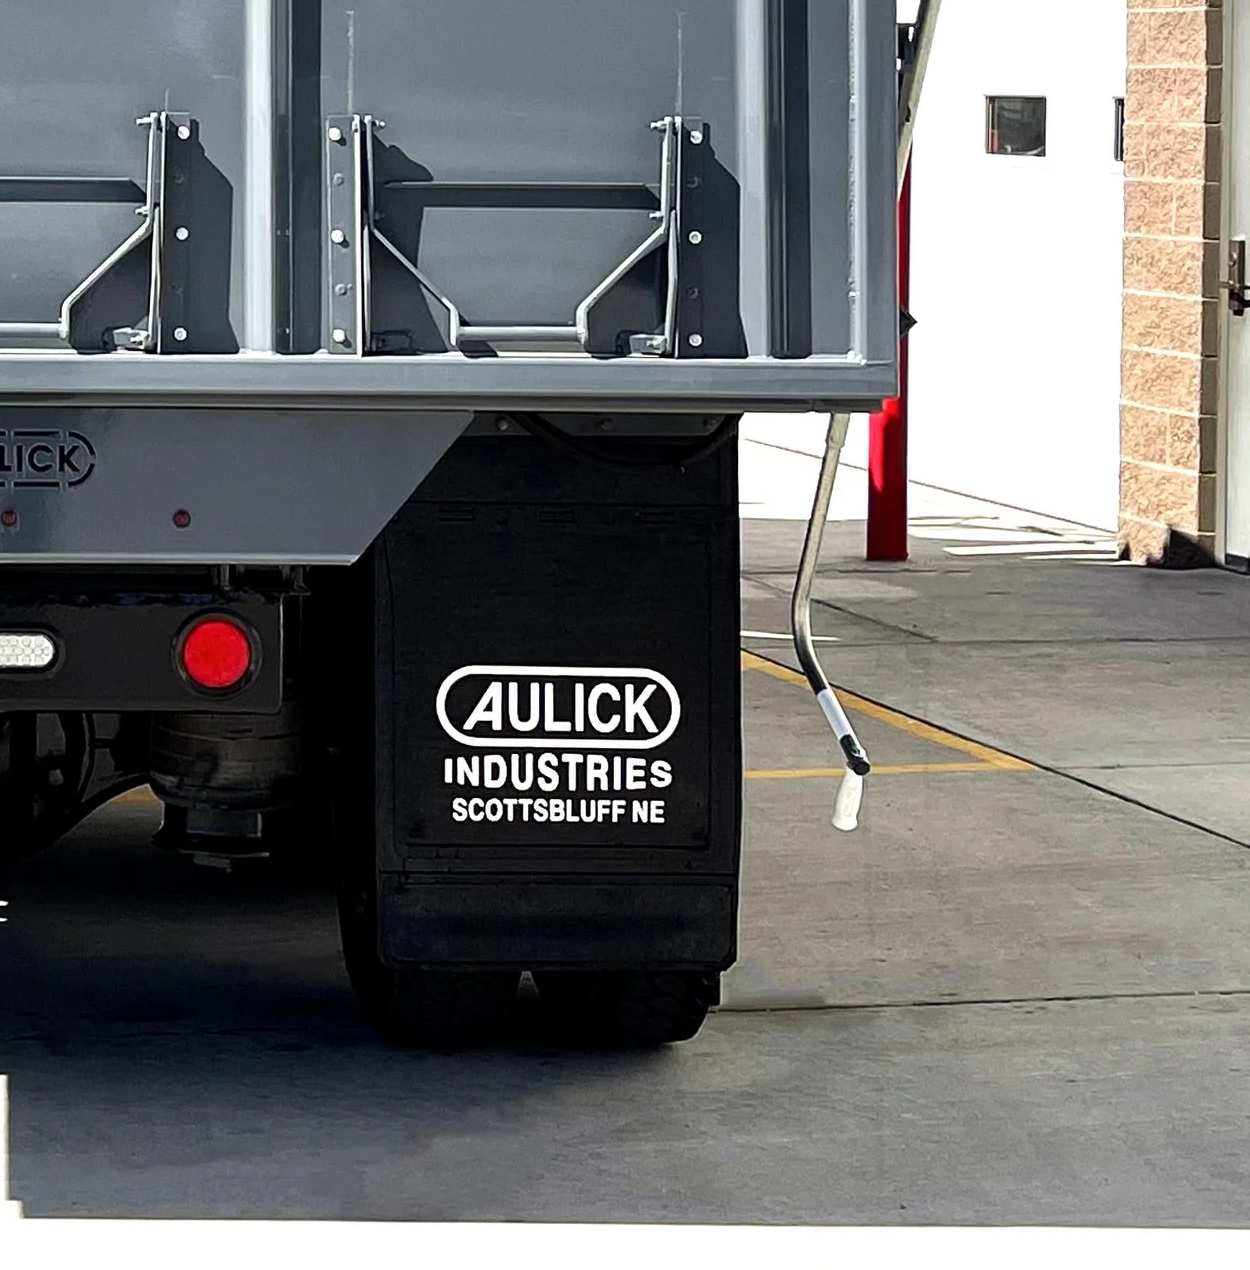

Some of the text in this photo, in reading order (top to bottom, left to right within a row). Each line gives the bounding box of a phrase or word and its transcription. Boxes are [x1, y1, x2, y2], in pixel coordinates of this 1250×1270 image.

[462, 681, 659, 733] AULICK
[444, 752, 672, 792] INDUSTRIES
[452, 797, 665, 824] SCOTTSBLUFF NE
